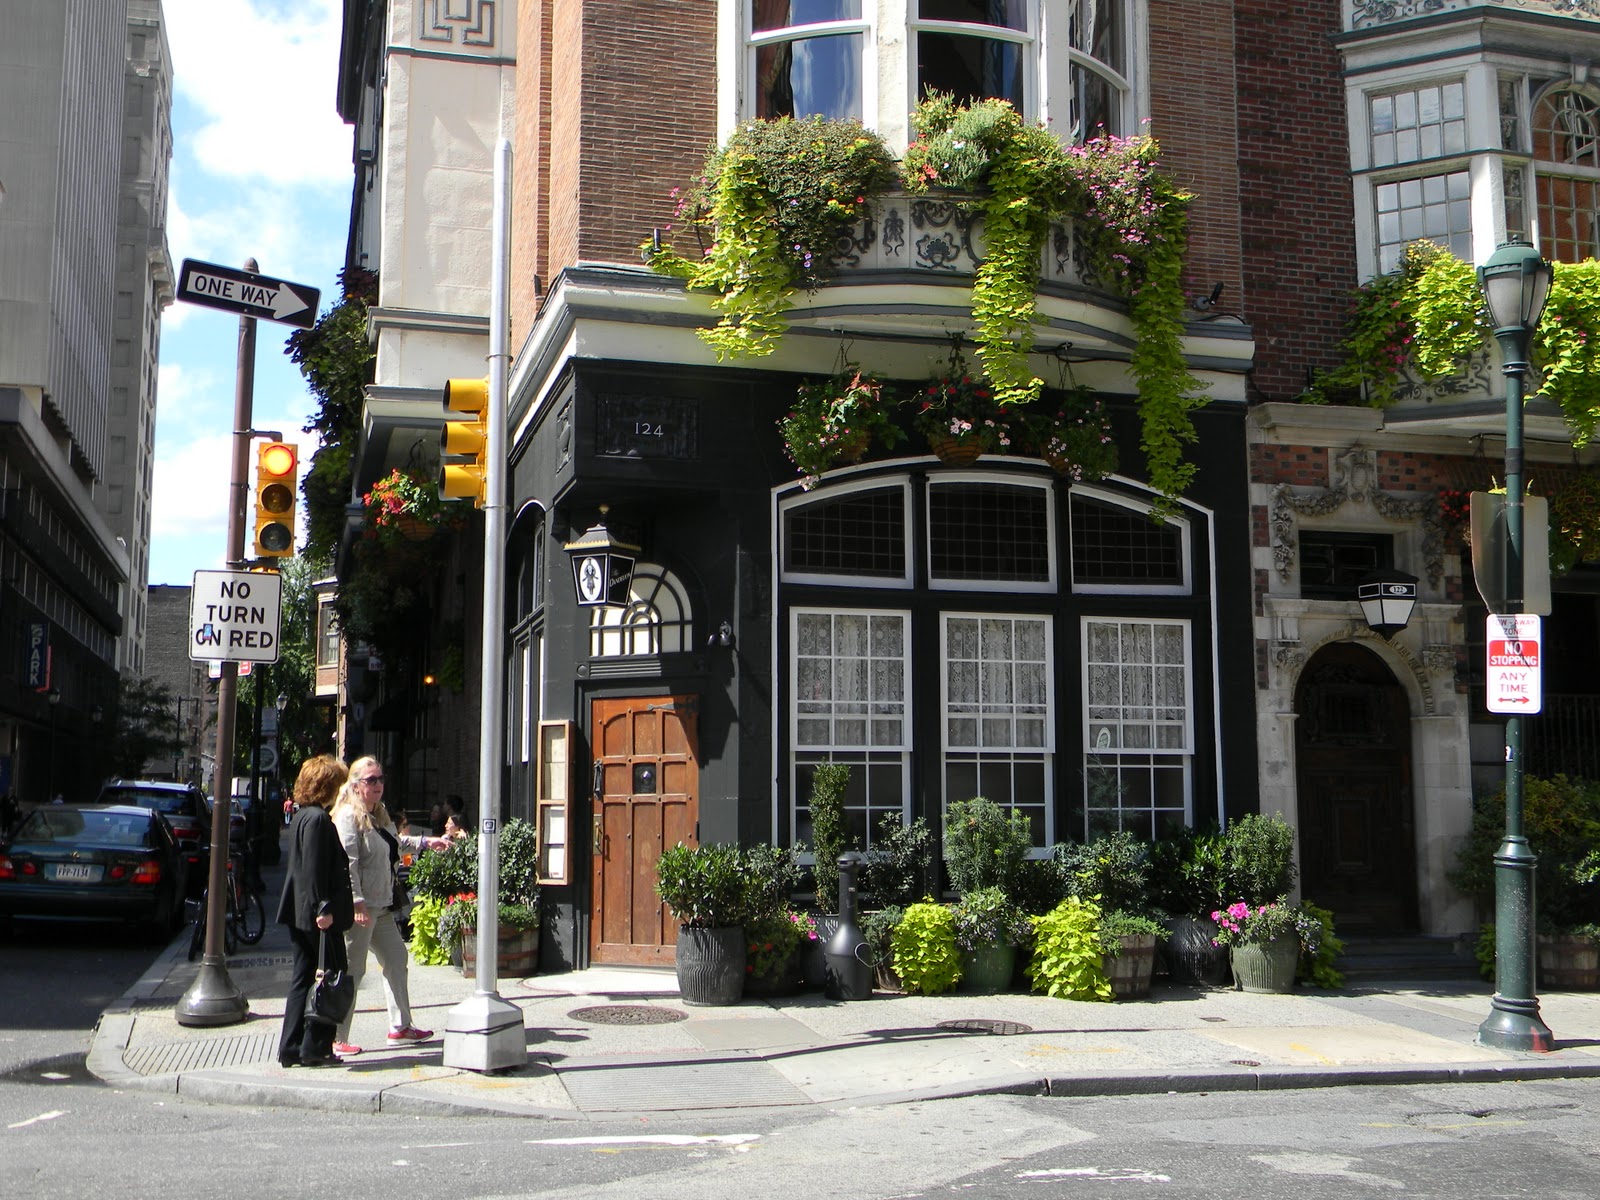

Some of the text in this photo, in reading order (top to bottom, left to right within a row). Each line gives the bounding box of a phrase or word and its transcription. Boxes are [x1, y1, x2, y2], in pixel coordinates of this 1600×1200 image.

[194, 275, 278, 307] ONE WAY
[635, 422, 664, 438] 124
[220, 581, 251, 599] NO
[206, 604, 265, 624] TURN
[195, 628, 274, 649] ON RED
[1503, 627, 1522, 636] ZONE
[1504, 641, 1523, 655] NO
[29, 636, 42, 686] PARK
[1490, 655, 1538, 666] STOPPING
[1499, 672, 1528, 681] ANY
[1499, 683, 1529, 694] TIME
